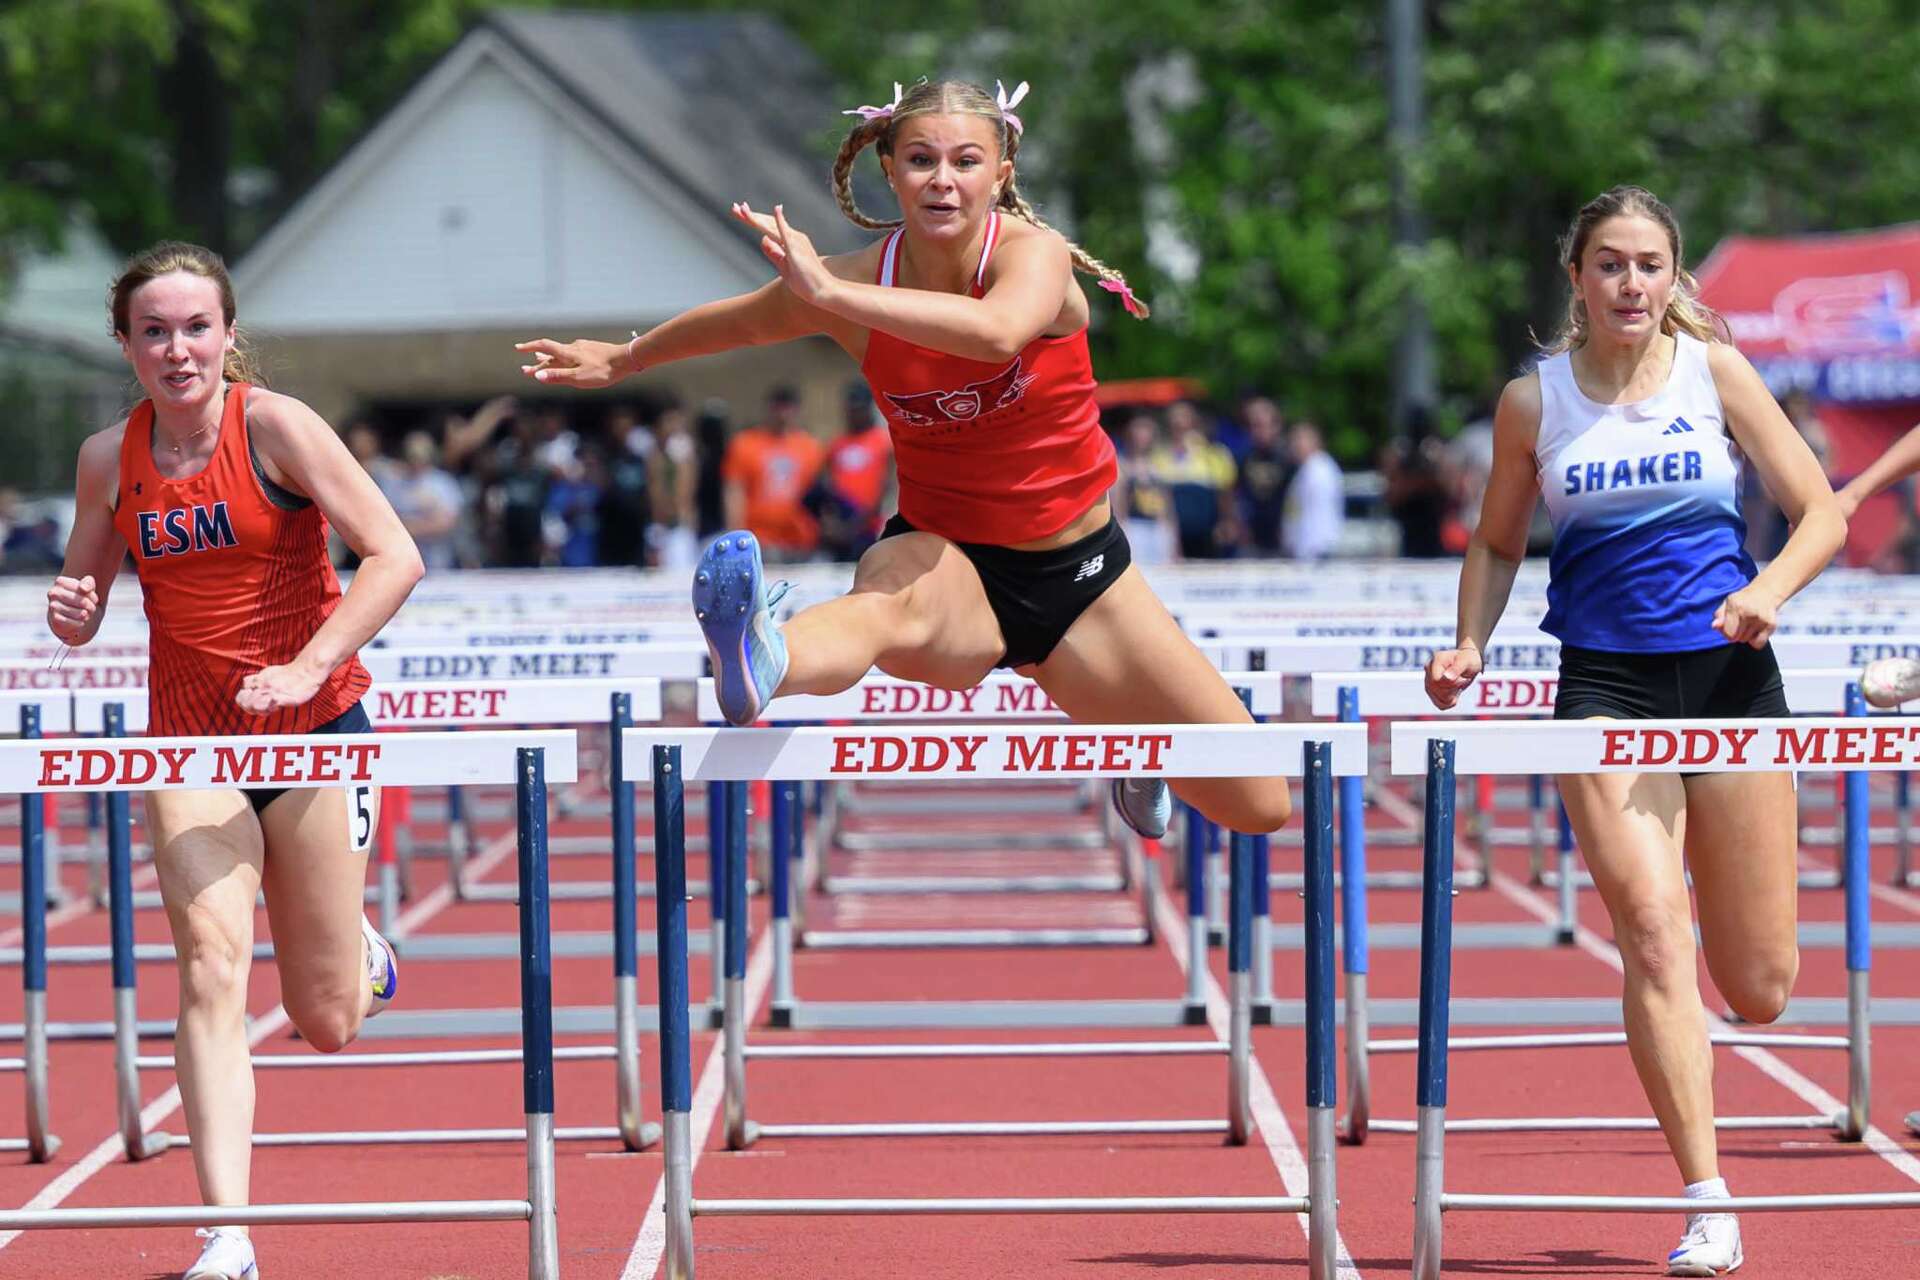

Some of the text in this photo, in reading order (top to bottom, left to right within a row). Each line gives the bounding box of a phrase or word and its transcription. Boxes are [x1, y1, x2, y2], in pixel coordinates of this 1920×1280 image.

[1565, 451, 1704, 495] SHAKER
[137, 500, 240, 559] ESM
[401, 652, 617, 678] EDDY MEET
[1361, 645, 1456, 668] EDD
[0, 666, 148, 690] ECTADY
[376, 689, 506, 719] MEET
[861, 685, 983, 713] EDDY
[37, 744, 382, 786] EDDY MEET
[830, 734, 1173, 773] EDDY MEET
[1600, 728, 1758, 766] EDDY
[349, 787, 372, 847] 5
